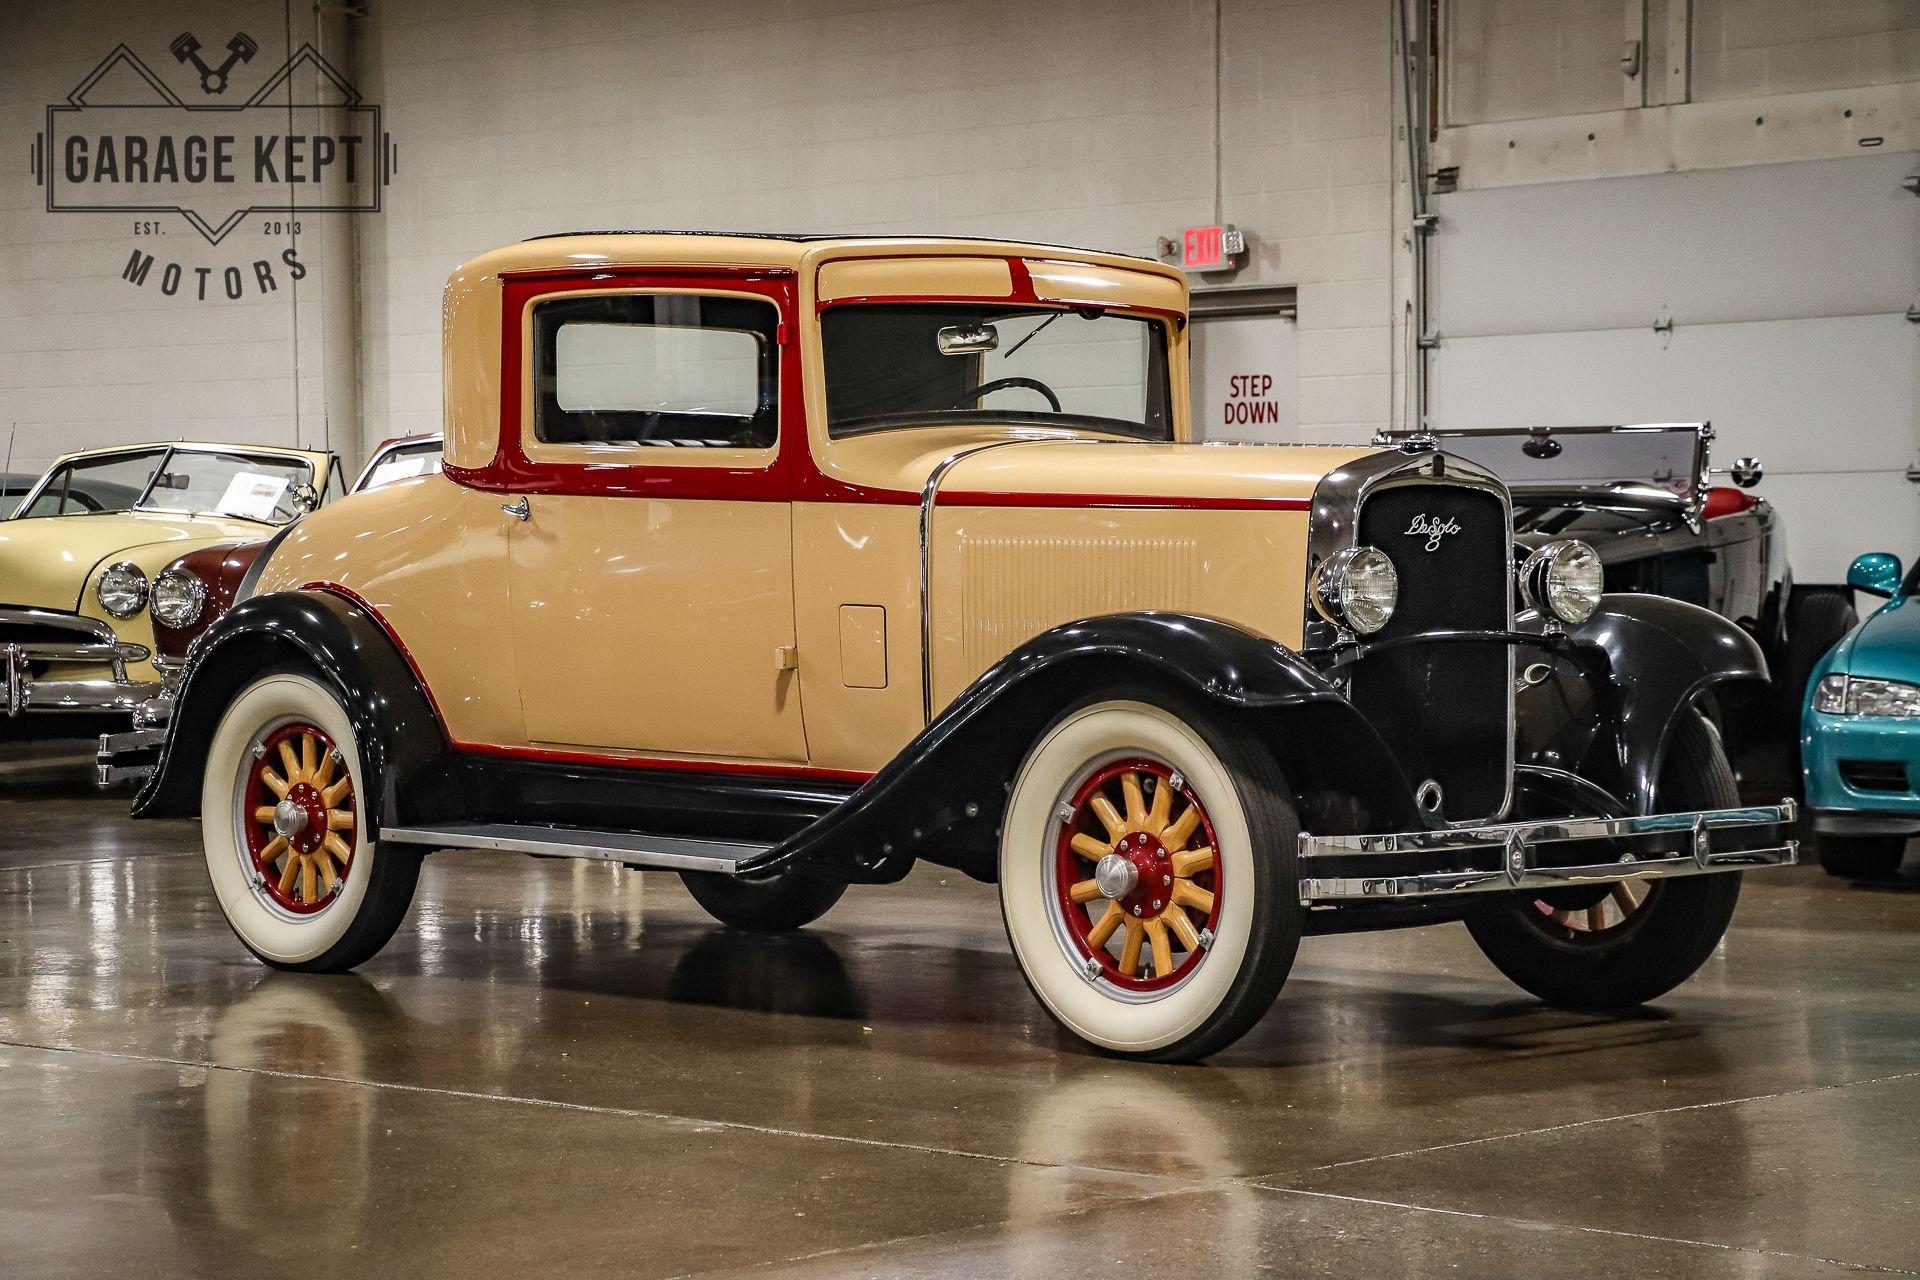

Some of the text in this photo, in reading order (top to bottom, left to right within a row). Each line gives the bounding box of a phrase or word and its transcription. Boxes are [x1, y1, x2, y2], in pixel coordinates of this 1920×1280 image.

[1184, 228, 1222, 266] EXIT
[1230, 374, 1273, 398] STEP
[1224, 401, 1279, 425] DOWN
[1403, 513, 1462, 552] DeSoto
